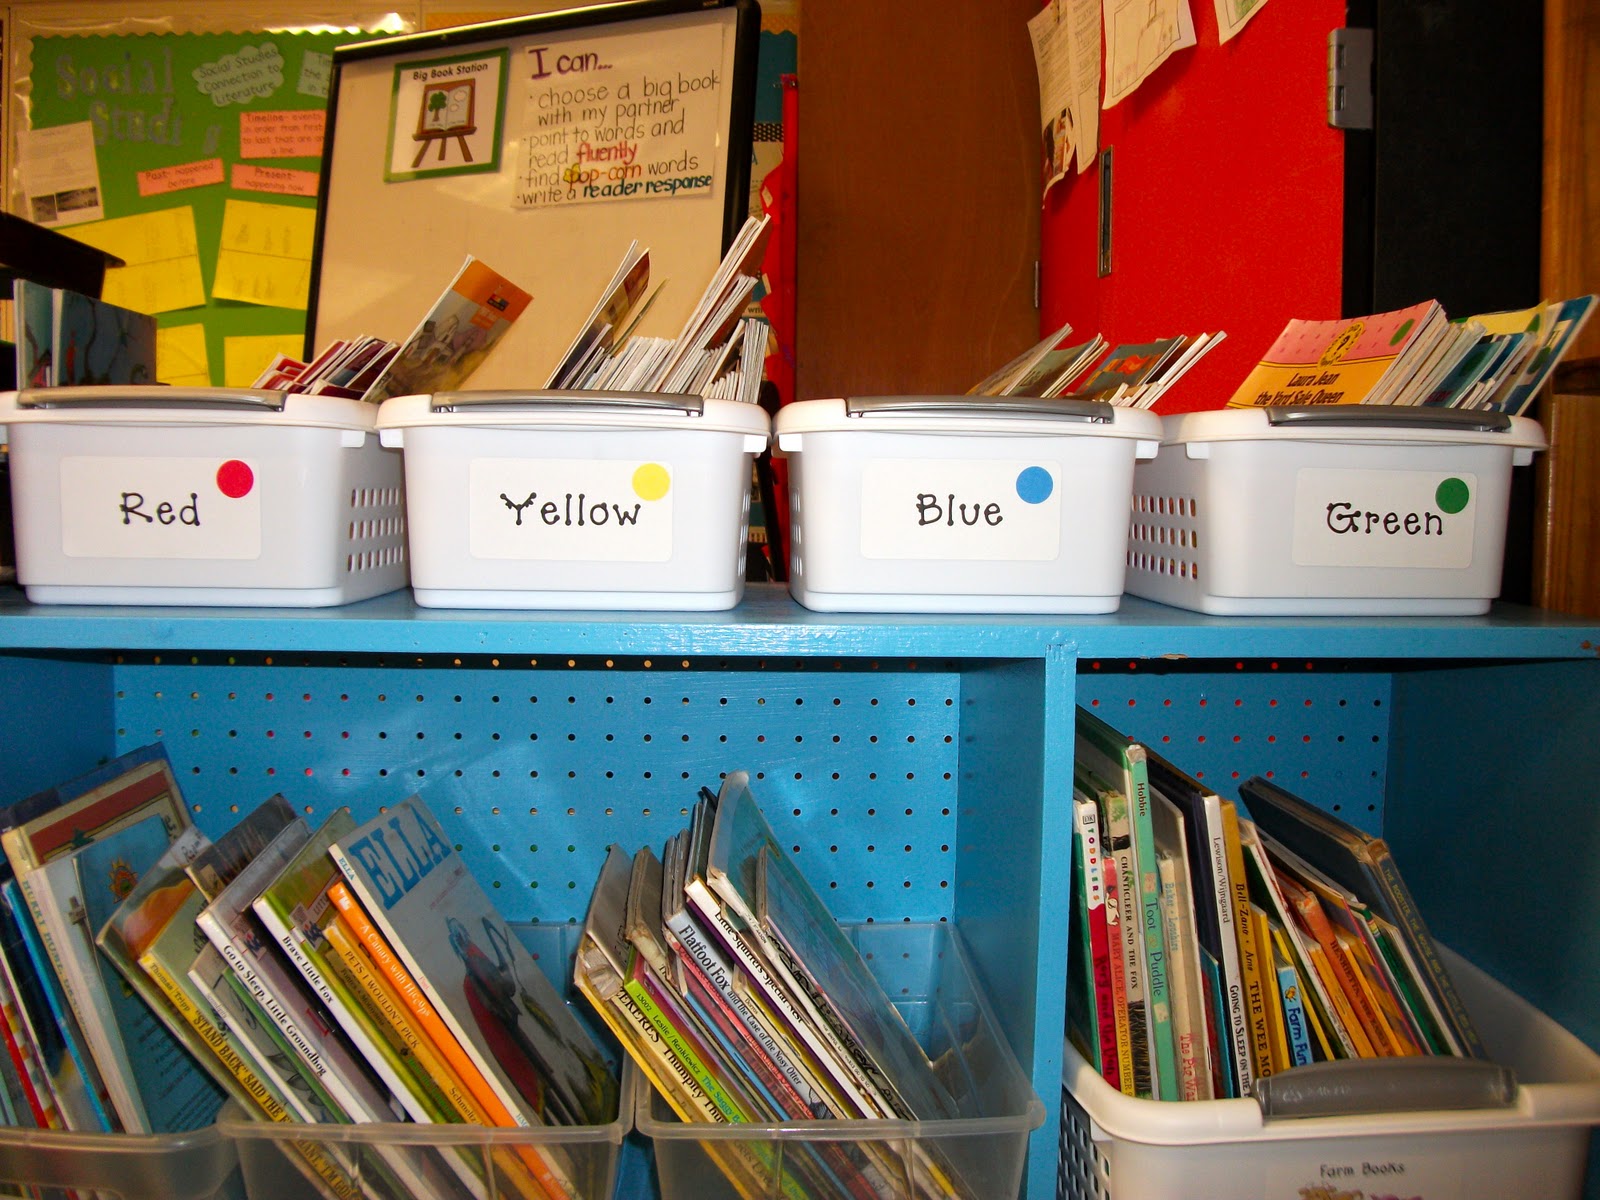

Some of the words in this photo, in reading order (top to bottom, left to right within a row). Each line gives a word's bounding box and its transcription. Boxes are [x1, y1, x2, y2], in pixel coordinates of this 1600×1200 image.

[56, 46, 174, 100] Social
[413, 71, 428, 81] Big
[431, 68, 453, 79] Book
[456, 63, 488, 75] Station
[528, 47, 552, 80] I
[538, 86, 609, 109] choose
[617, 83, 630, 100] a
[643, 76, 672, 101] big
[678, 69, 721, 95] book
[529, 128, 568, 150] point
[573, 126, 590, 143] to
[594, 118, 645, 142] words
[651, 108, 685, 137] and
[538, 106, 572, 127] with
[582, 106, 607, 129] my
[615, 97, 679, 127] partner
[527, 166, 560, 188] find
[647, 149, 699, 176] words
[529, 144, 569, 169] read
[576, 140, 637, 164] fluently
[523, 188, 562, 205] write
[566, 187, 576, 200] a
[583, 179, 644, 199] reader
[646, 174, 712, 196] response
[1286, 372, 1317, 388] Laura
[1312, 370, 1341, 386] Jean
[1254, 391, 1272, 405] the
[1270, 391, 1293, 405] Yard
[1290, 390, 1313, 405] Sale
[1311, 389, 1345, 405] Queen
[119, 491, 201, 527] Red
[499, 491, 642, 527] Yellow
[915, 492, 1004, 527] Blue
[1326, 502, 1443, 536] Green
[1137, 782, 1146, 817] Hobbie
[339, 857, 355, 881] ELLA
[347, 803, 453, 911] ELLA
[1087, 827, 1100, 901] TODDLERS
[1121, 855, 1132, 922] CHANTICLEER
[1213, 836, 1230, 924] Lewison/Wijngaard
[1385, 868, 1394, 882] THE
[1145, 897, 1160, 930] Toot
[1112, 932, 1122, 961] MARY
[1126, 925, 1135, 946] AND
[282, 936, 303, 962] Brave
[301, 961, 322, 988] Little
[319, 985, 335, 1004] Fox
[360, 925, 370, 936] A
[367, 933, 392, 965] Canary
[390, 963, 407, 985] with
[403, 982, 432, 1018] Hiccups
[1128, 951, 1136, 969] THE
[1150, 951, 1163, 998] Puddle
[1114, 964, 1124, 997] ALICE,
[1130, 970, 1138, 990] FOX
[1249, 981, 1261, 1010] THE
[174, 992, 191, 1013] Tripp
[223, 945, 236, 962] Go
[234, 958, 245, 972] to
[243, 970, 266, 1001] Sleep,
[265, 999, 288, 1026] Little
[285, 1023, 327, 1078] Groundhog
[344, 950, 365, 975] PETS
[362, 973, 369, 981] I
[367, 980, 404, 1027] WOULDN'T
[401, 1026, 421, 1050] PICK
[678, 923, 716, 973] Flatfoot
[711, 967, 731, 992] Fox
[726, 990, 740, 1007] and
[736, 1002, 750, 1018] the
[745, 1013, 762, 1034] Case
[758, 1030, 770, 1043] of
[765, 1037, 777, 1053] the
[773, 1047, 789, 1069] Nosy
[785, 1065, 803, 1086] Otter
[1229, 984, 1241, 1014] GOING
[1115, 995, 1129, 1049] OPERATOR
[1233, 1014, 1242, 1026] TO
[1253, 1017, 1267, 1052] WEE
[1288, 1007, 1303, 1040] Farm
[1179, 1033, 1191, 1053] The
[1235, 1026, 1247, 1058] SLEEP
[652, 1014, 669, 1036] Leslie
[671, 1038, 701, 1075] Renkiewicz
[702, 1075, 714, 1092] The
[713, 1090, 734, 1115] Saggy
[663, 1047, 706, 1100] Thumpity
[1121, 1049, 1132, 1091] NUMBER
[1240, 1058, 1249, 1071] ON
[243, 1072, 266, 1099] SAID
[266, 1097, 283, 1119] THE
[1242, 1072, 1251, 1091] THE
[1319, 1163, 1355, 1179] Farm
[1361, 1161, 1406, 1176] Books
